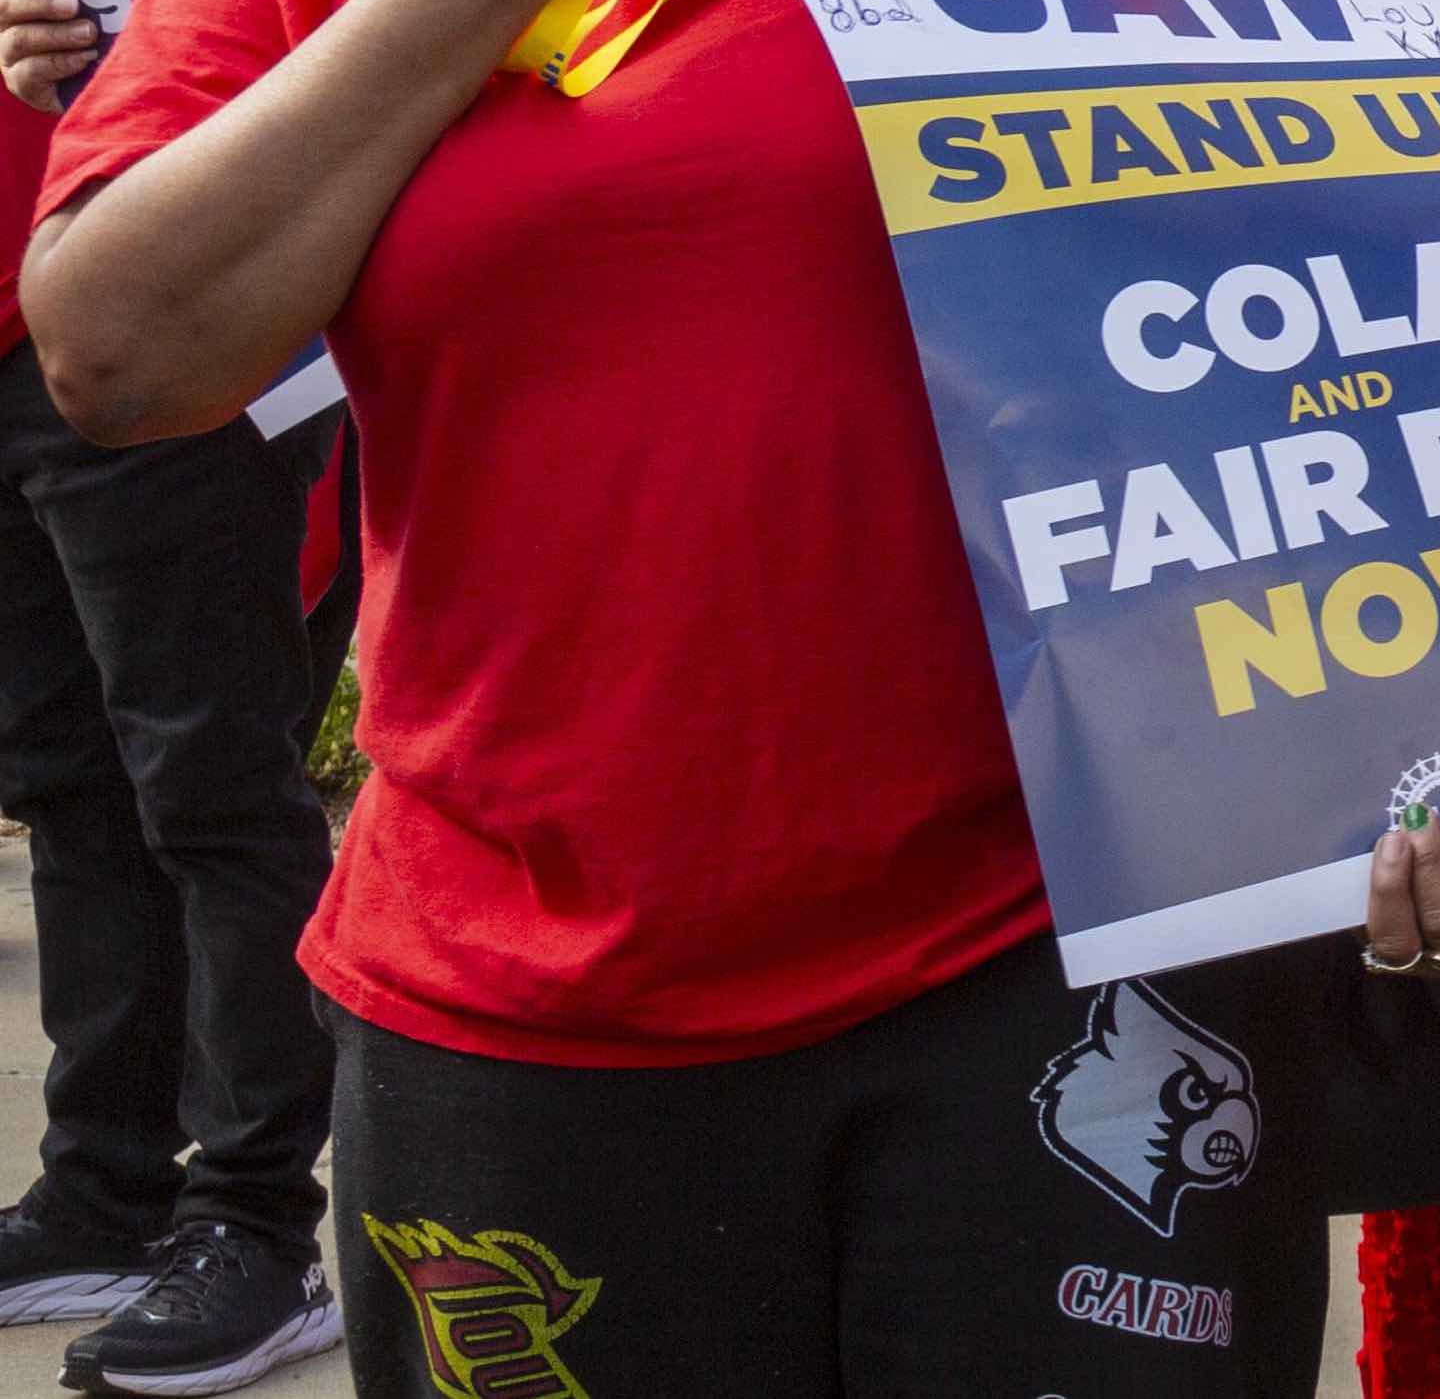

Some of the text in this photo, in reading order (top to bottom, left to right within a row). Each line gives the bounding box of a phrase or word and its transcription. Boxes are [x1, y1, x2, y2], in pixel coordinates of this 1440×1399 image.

[920, 98, 1333, 202] STAND
[1288, 370, 1394, 422] AND
[1002, 431, 1389, 610] FAIR
[1057, 1263, 1233, 1347] CARDS
